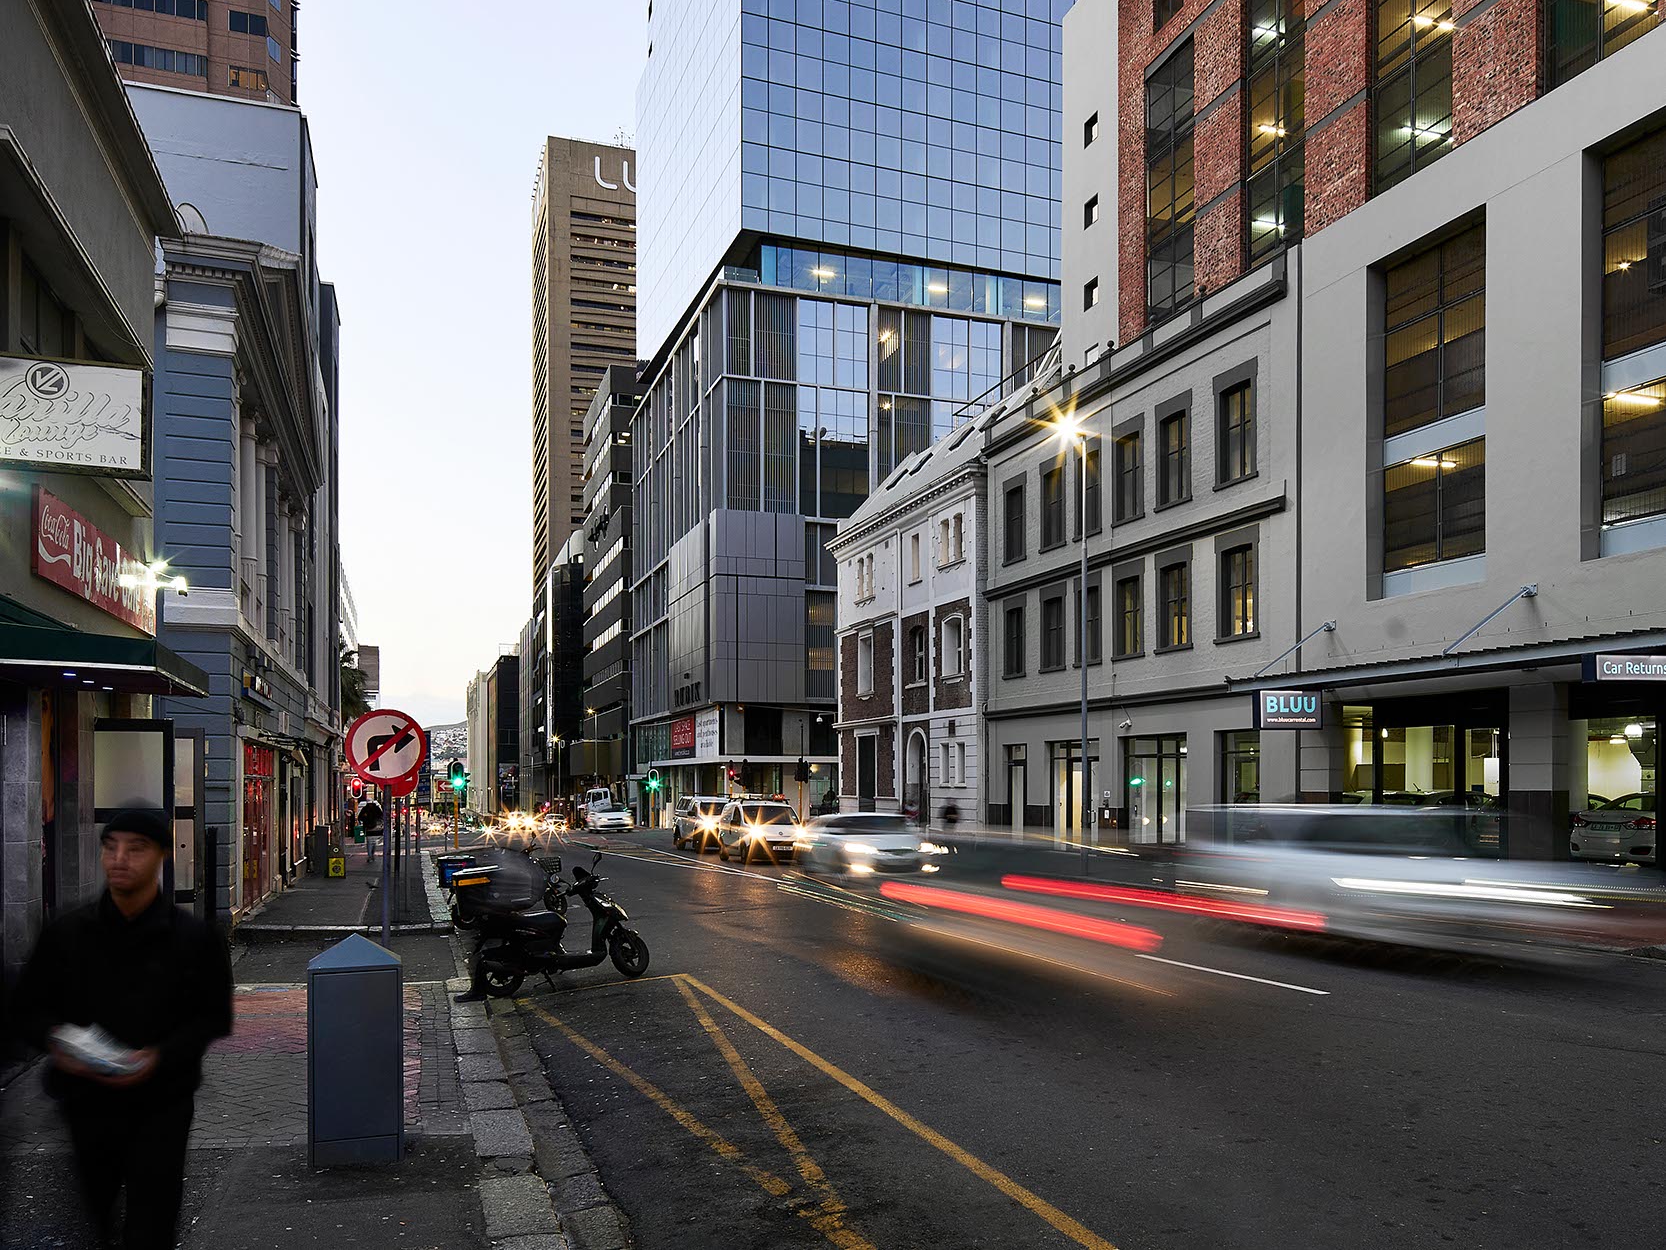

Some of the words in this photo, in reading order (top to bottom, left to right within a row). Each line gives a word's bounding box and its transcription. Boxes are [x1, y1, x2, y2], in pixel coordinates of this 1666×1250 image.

[1, 417, 99, 449] Lounge
[19, 448, 29, 457] &
[36, 449, 92, 462] SPORTS
[100, 454, 128, 465] BAR
[73, 519, 93, 600] Big
[94, 536, 120, 602] Save
[1603, 661, 1623, 674] Car
[1266, 695, 1317, 713] BLUU
